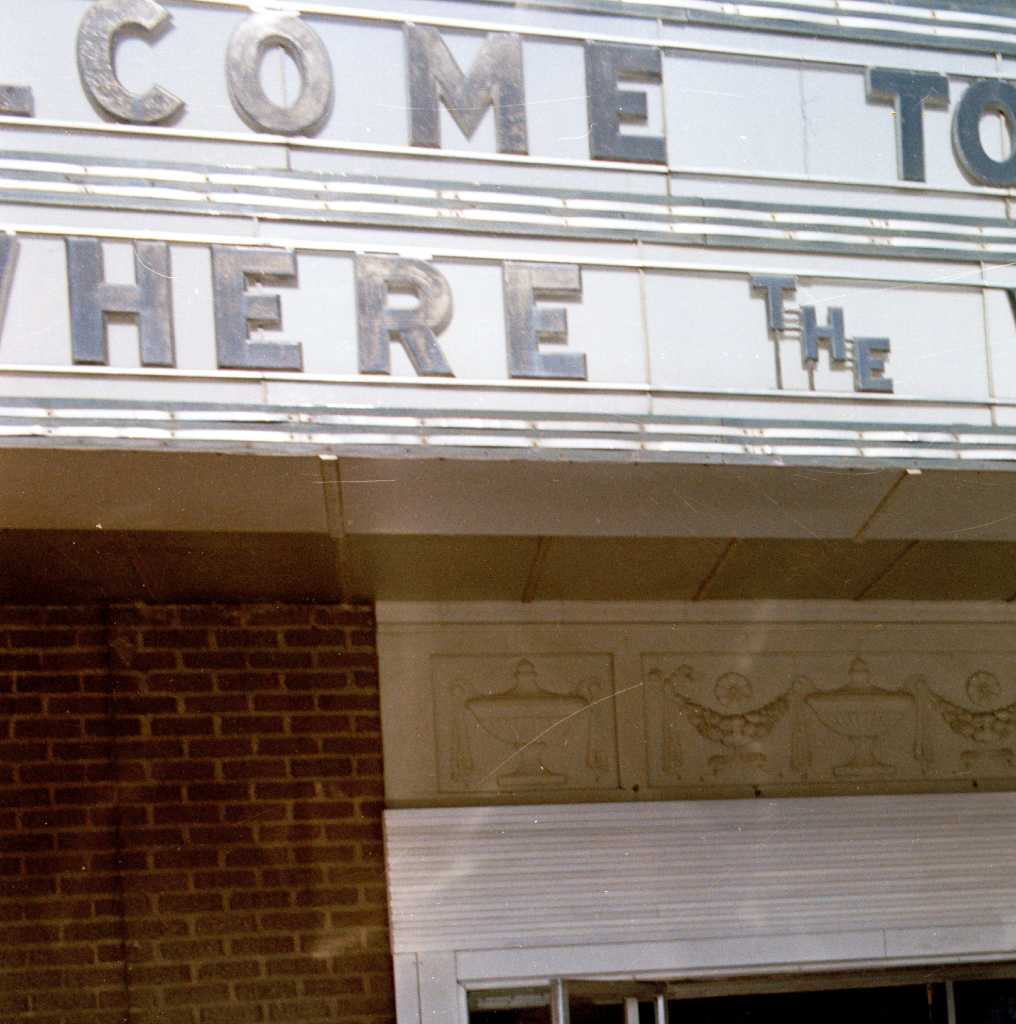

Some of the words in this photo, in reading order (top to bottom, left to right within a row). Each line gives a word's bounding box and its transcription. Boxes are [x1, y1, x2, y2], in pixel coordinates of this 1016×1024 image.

[0, 0, 668, 164] COME
[0, 229, 588, 381] HERE
[750, 275, 893, 393] THE
